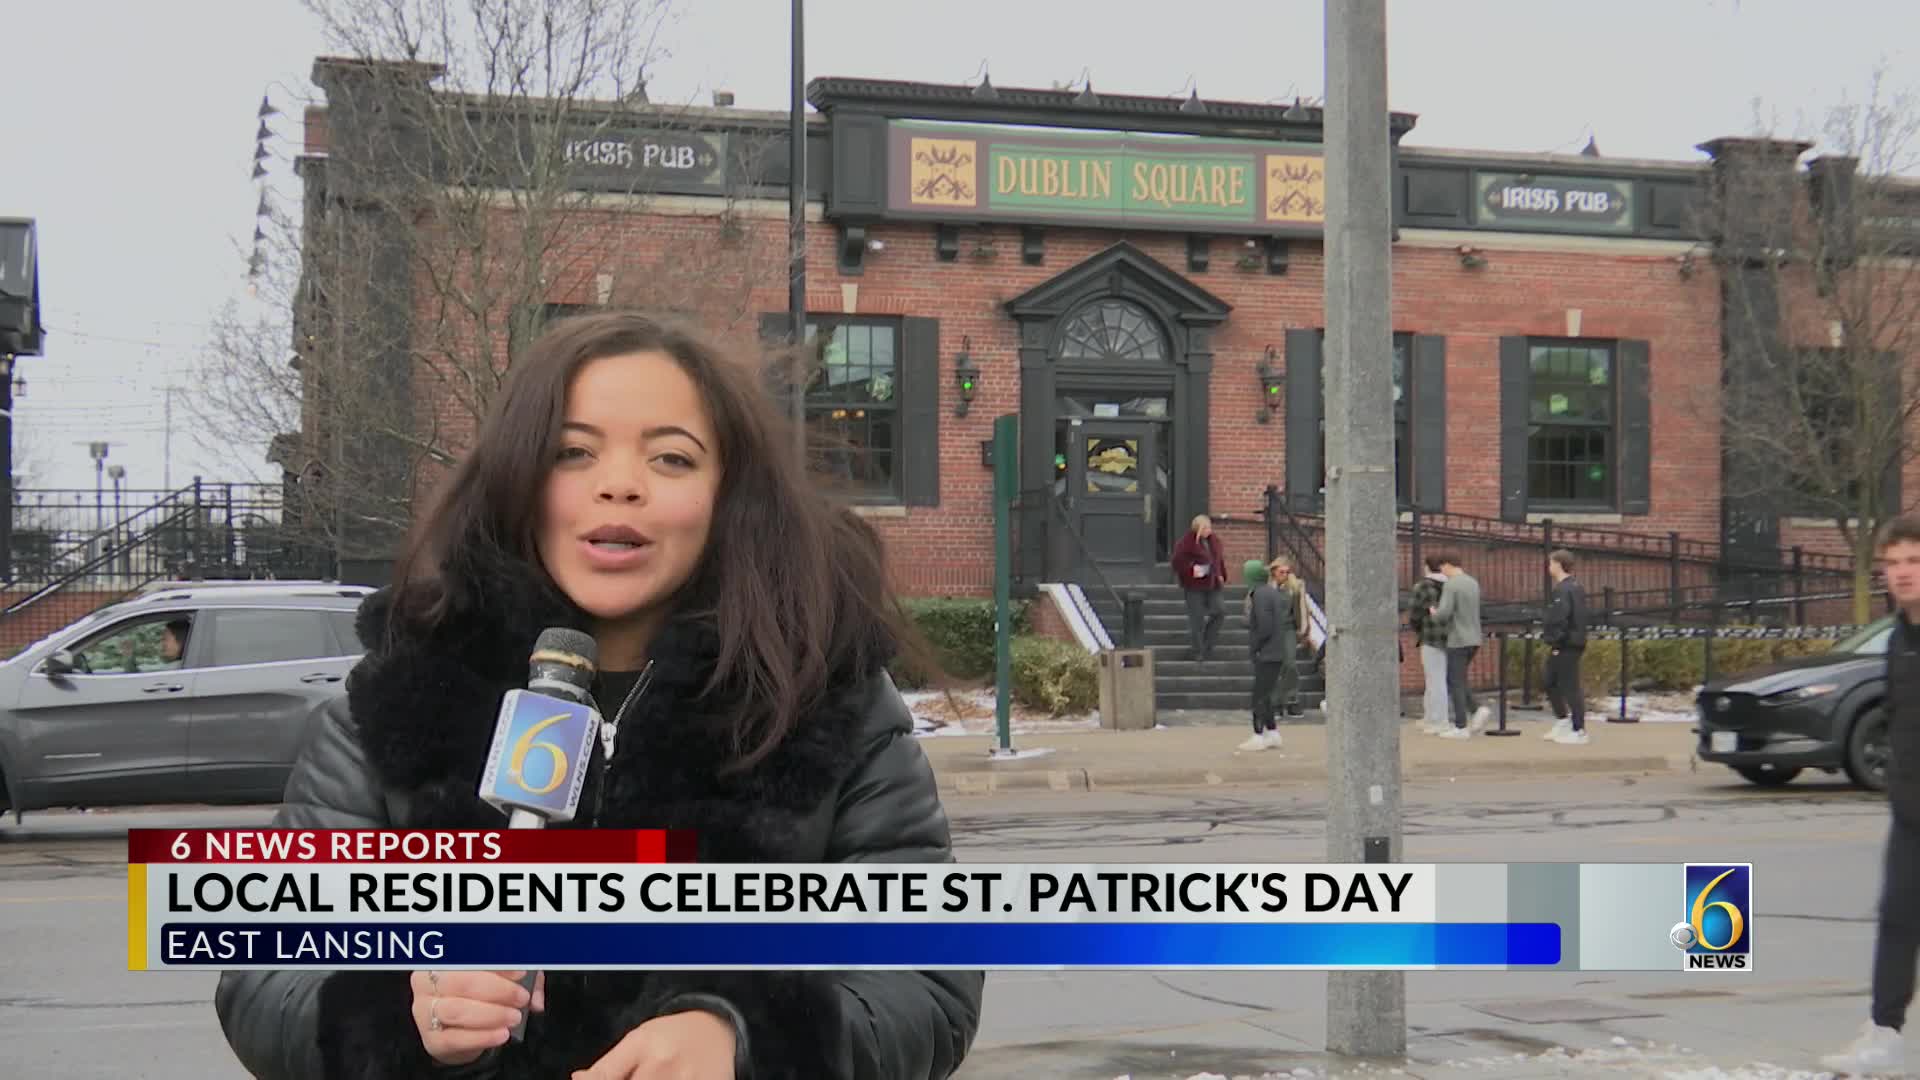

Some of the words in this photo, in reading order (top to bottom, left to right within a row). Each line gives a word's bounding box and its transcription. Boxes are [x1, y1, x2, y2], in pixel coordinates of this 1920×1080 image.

[643, 144, 696, 169] PUB
[997, 156, 1112, 199] DUBLIN
[1132, 162, 1246, 207] SQUARE
[1502, 187, 1560, 213] IRISH
[1565, 190, 1609, 213] PUB
[510, 712, 573, 795] 6
[569, 719, 598, 808] WLNS.COM
